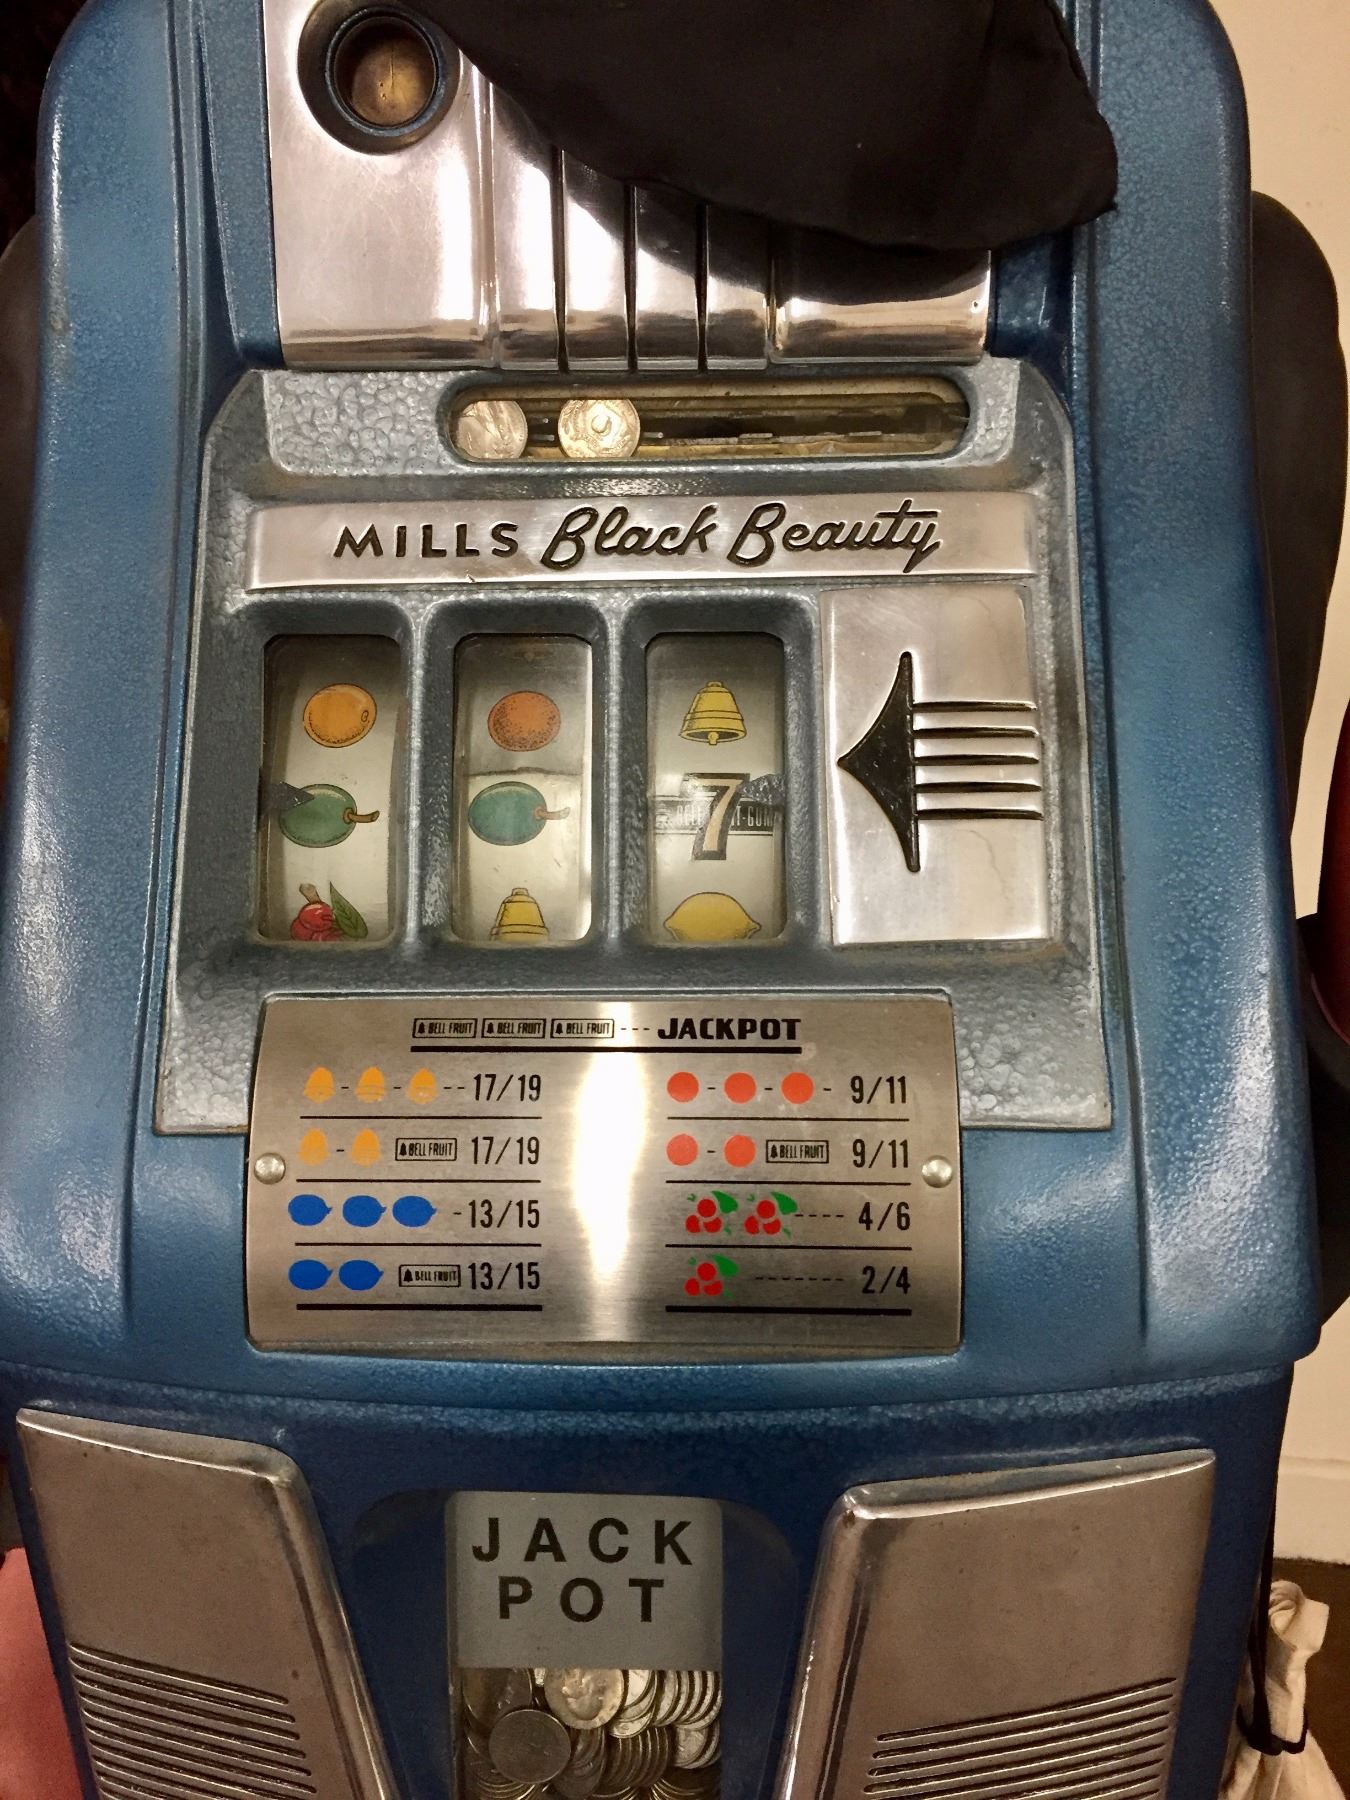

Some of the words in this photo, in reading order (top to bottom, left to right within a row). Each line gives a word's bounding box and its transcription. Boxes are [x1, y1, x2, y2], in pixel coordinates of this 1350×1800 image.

[333, 521, 519, 559] MILLS
[539, 502, 719, 570] Black
[726, 498, 944, 574] Beauty
[682, 772, 750, 861] 7
[428, 1022, 446, 1034] BELL
[450, 1022, 473, 1034] FRUIT
[497, 1022, 515, 1034] BELL
[518, 1022, 542, 1034] FRUIT
[566, 1022, 584, 1035] BELL
[587, 1022, 610, 1035] FRUIT
[658, 1018, 802, 1041] JACKPOT
[473, 1073, 541, 1102] 17/19
[850, 1075, 907, 1105] 9/11
[408, 1142, 426, 1156] BELL
[428, 1142, 453, 1156] FRUIT
[471, 1136, 540, 1165] 17/19
[780, 1144, 797, 1158] BELL
[800, 1144, 825, 1159] FRUIT
[852, 1138, 909, 1168] 9/11
[468, 1199, 540, 1228] 13/15
[858, 1201, 911, 1231] 4/6
[415, 1270, 432, 1281] BELL
[433, 1270, 457, 1282] FRUIT
[468, 1262, 540, 1290] 13/15
[861, 1265, 911, 1294] 2/4
[472, 1517, 693, 1566] JACK
[498, 1575, 665, 1623] POT
